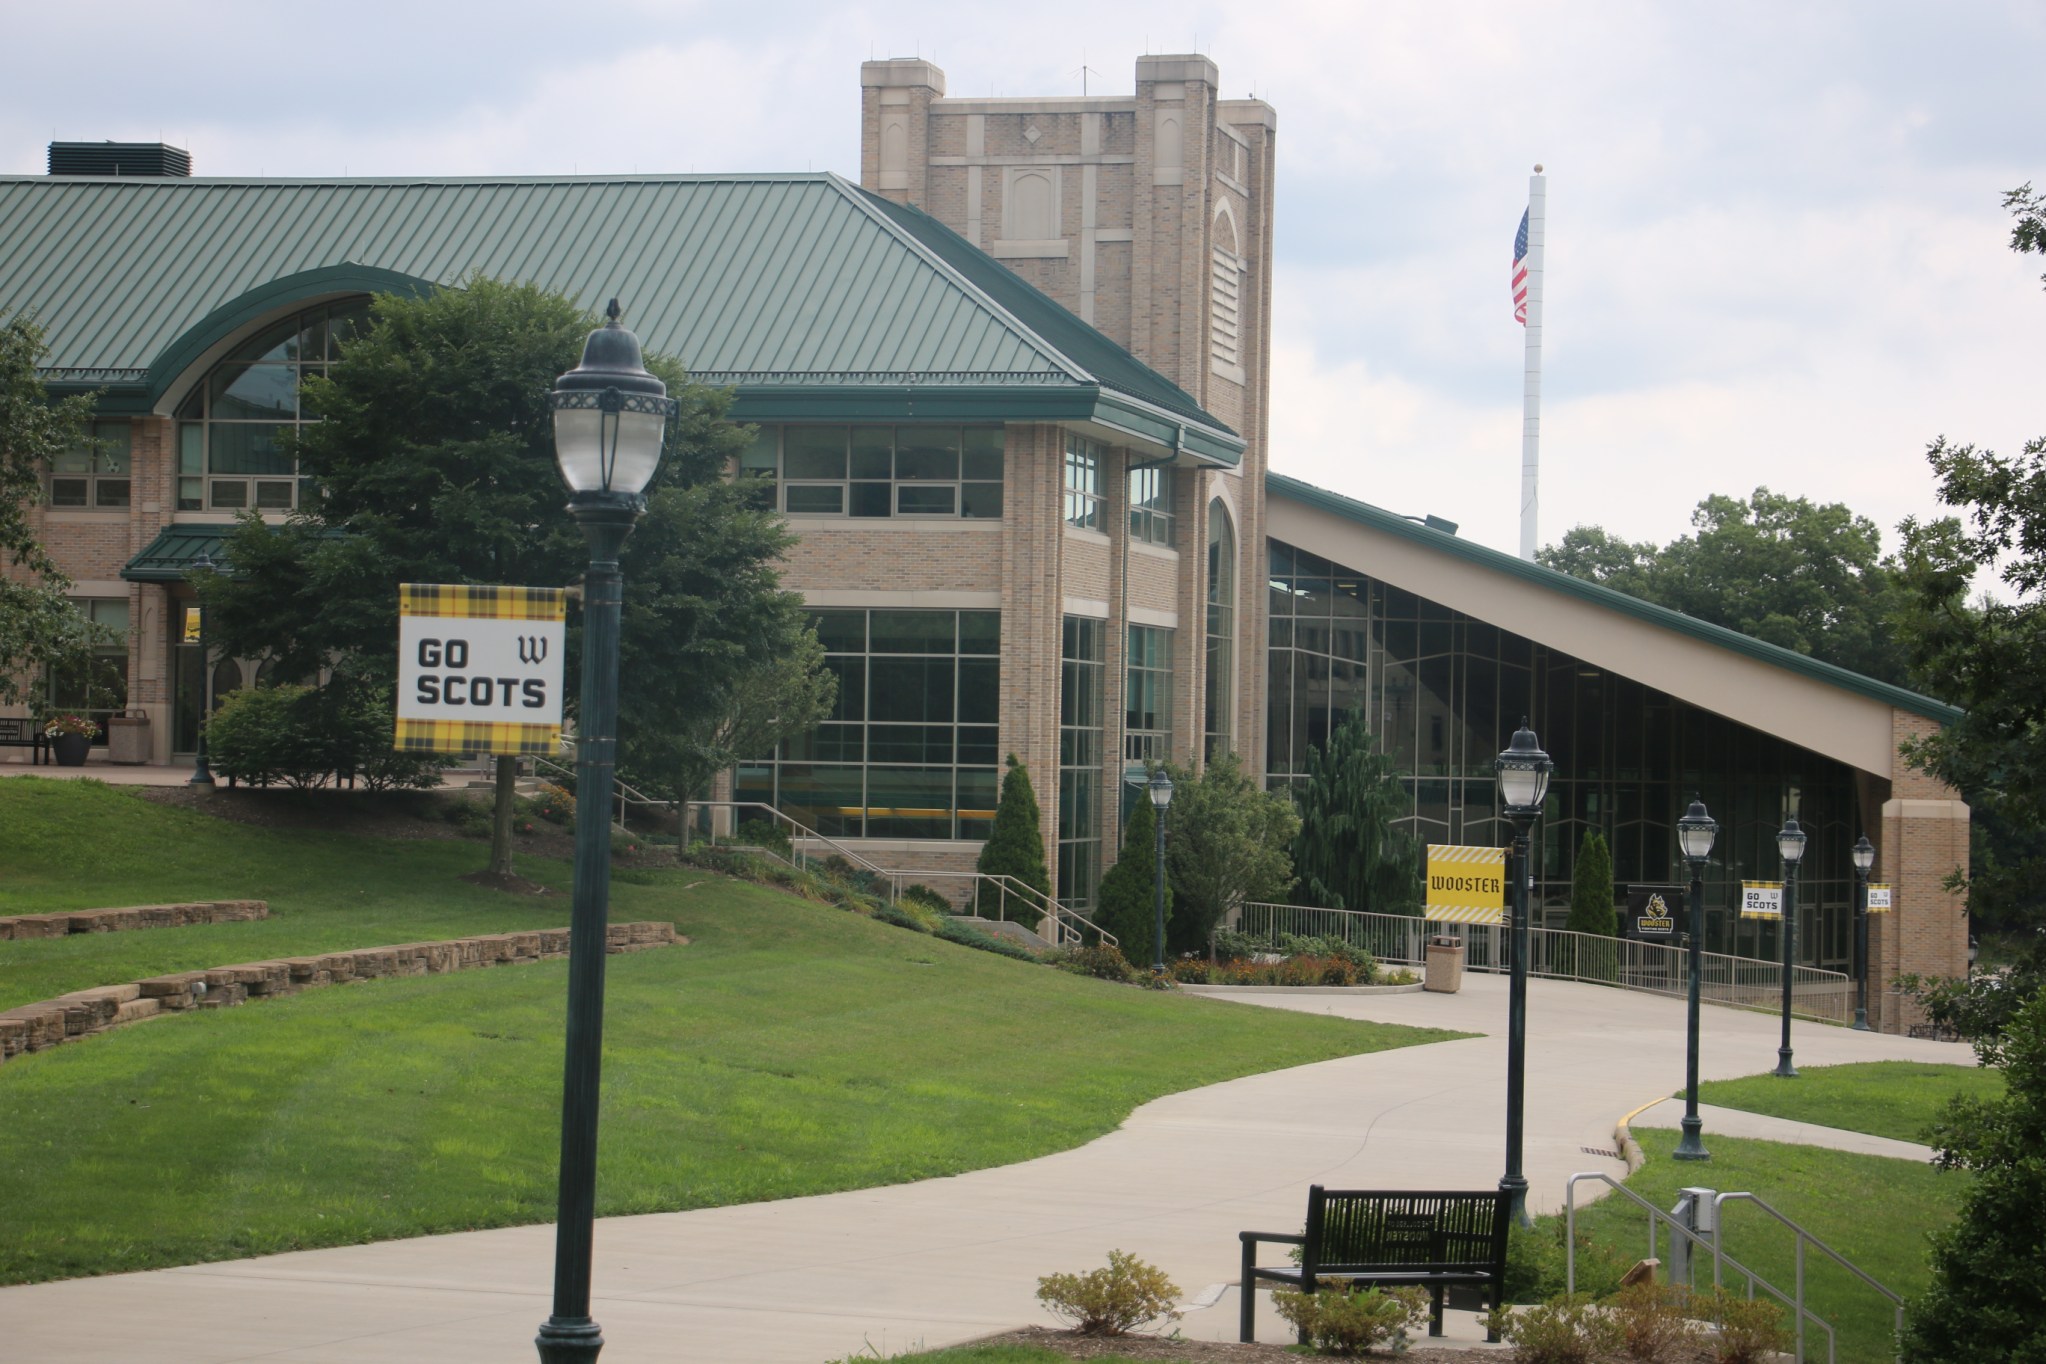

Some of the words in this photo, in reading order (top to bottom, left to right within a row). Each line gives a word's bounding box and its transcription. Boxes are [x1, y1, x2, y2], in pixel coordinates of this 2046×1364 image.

[418, 637, 469, 669] GO
[517, 634, 548, 665] W
[416, 674, 547, 709] SCOTS
[1431, 875, 1500, 893] WOOSTER
[1747, 892, 1759, 900] GO
[1746, 901, 1778, 910] SCOTS
